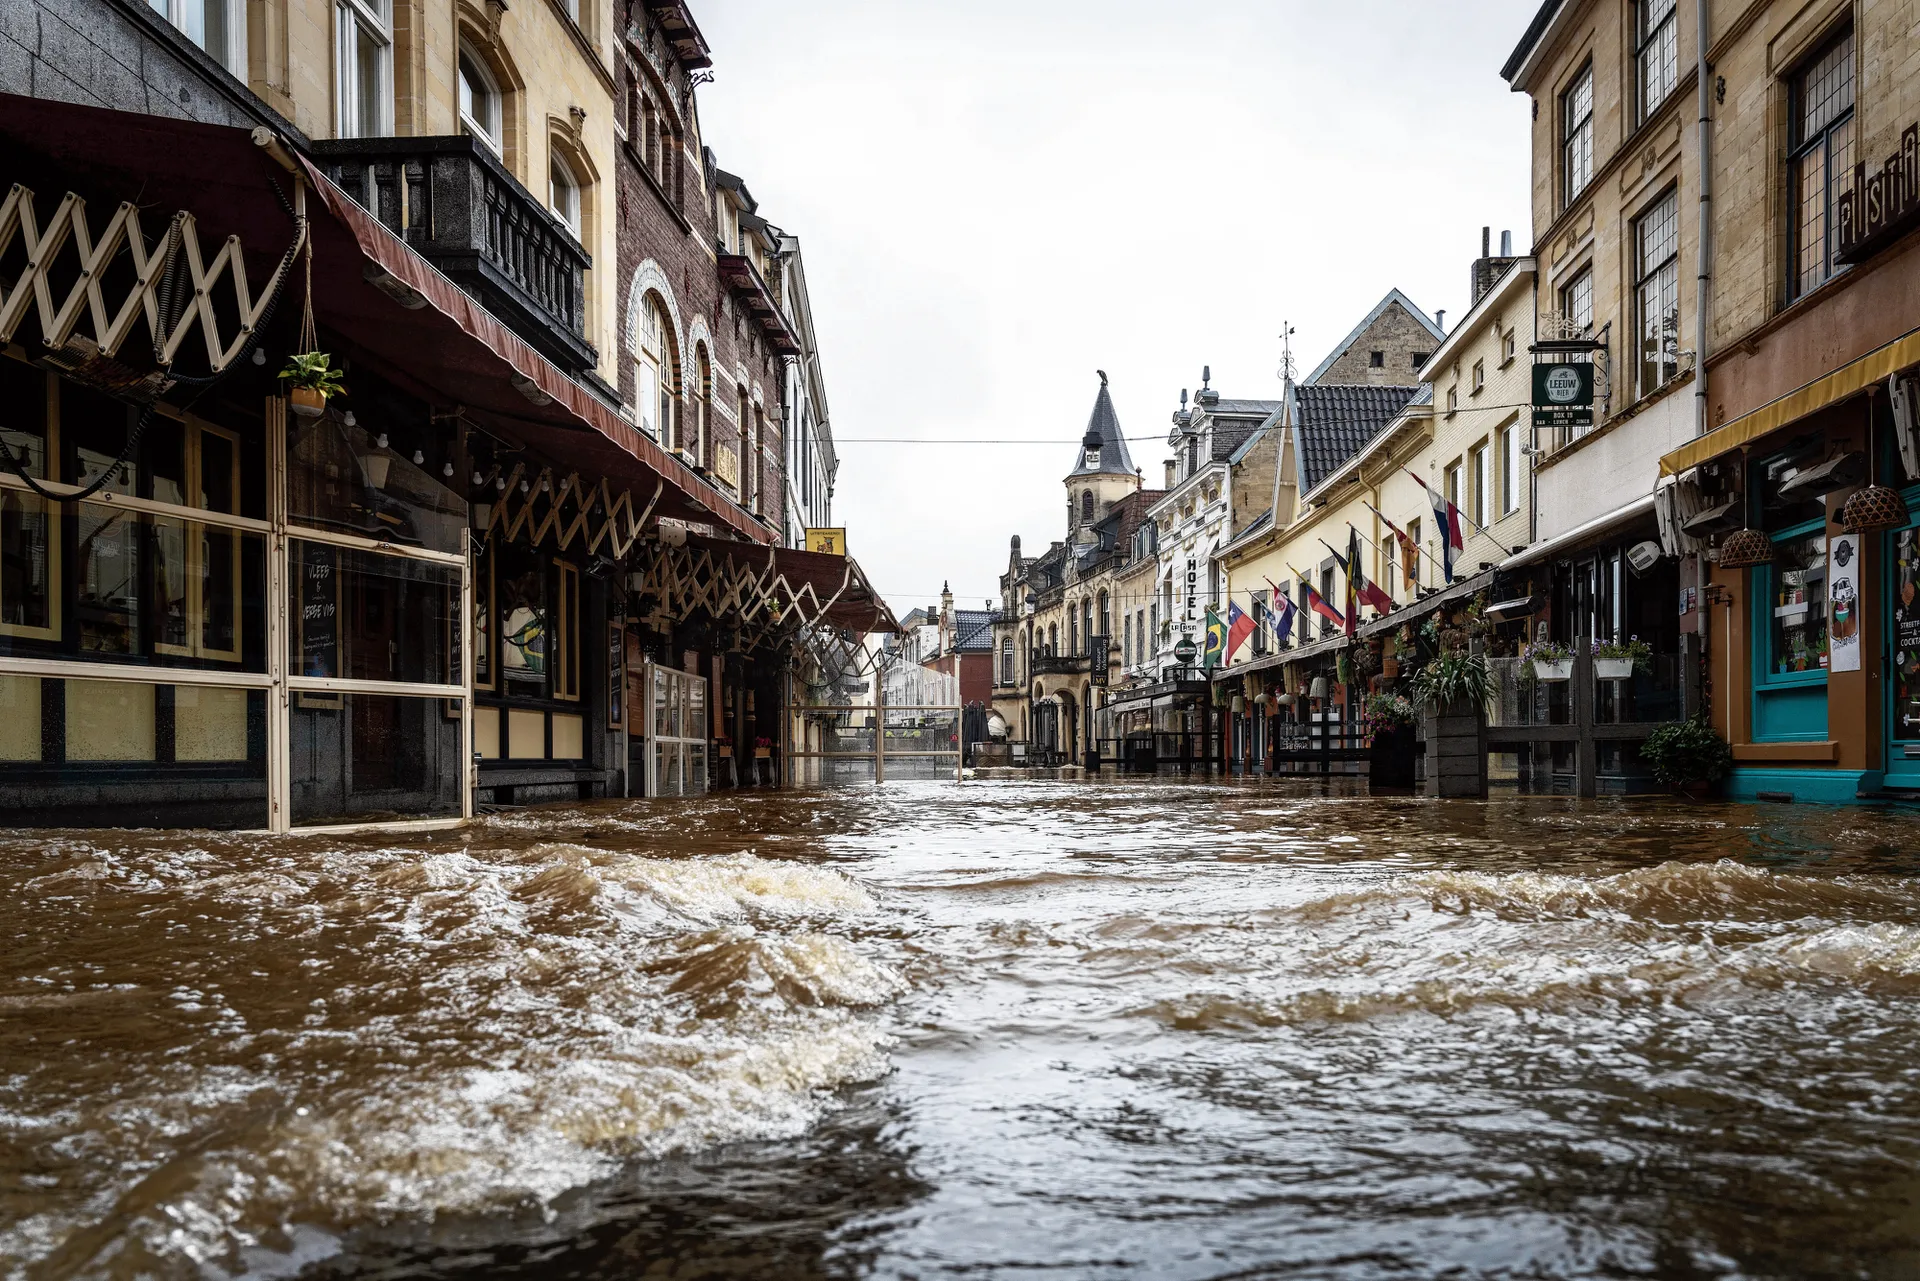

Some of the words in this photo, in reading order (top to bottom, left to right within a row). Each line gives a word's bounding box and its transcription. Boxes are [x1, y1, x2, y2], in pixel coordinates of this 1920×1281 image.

[1549, 379, 1577, 389] LEEUW
[1556, 389, 1569, 397] BIER
[308, 564, 330, 579] VLEES
[1187, 559, 1197, 621] HOTEL
[323, 603, 335, 617] VIS
[1180, 622, 1197, 632] CASA
